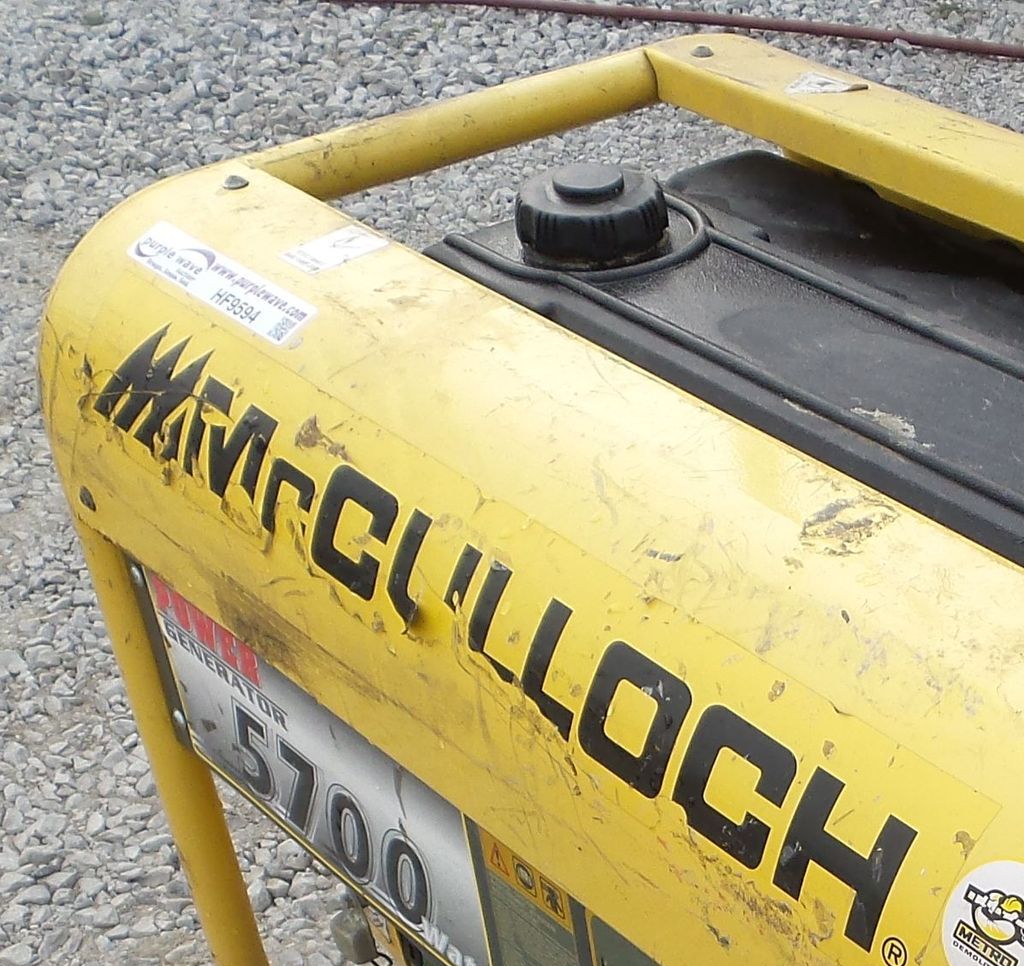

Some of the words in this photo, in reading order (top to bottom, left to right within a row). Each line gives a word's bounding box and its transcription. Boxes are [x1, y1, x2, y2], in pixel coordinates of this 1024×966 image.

[141, 236, 176, 259] purple
[176, 255, 203, 275] wave
[210, 288, 261, 324] HF9594
[211, 260, 308, 320] www.purplewave.com
[164, 622, 288, 731] GENERATOR
[231, 696, 435, 931] 5700
